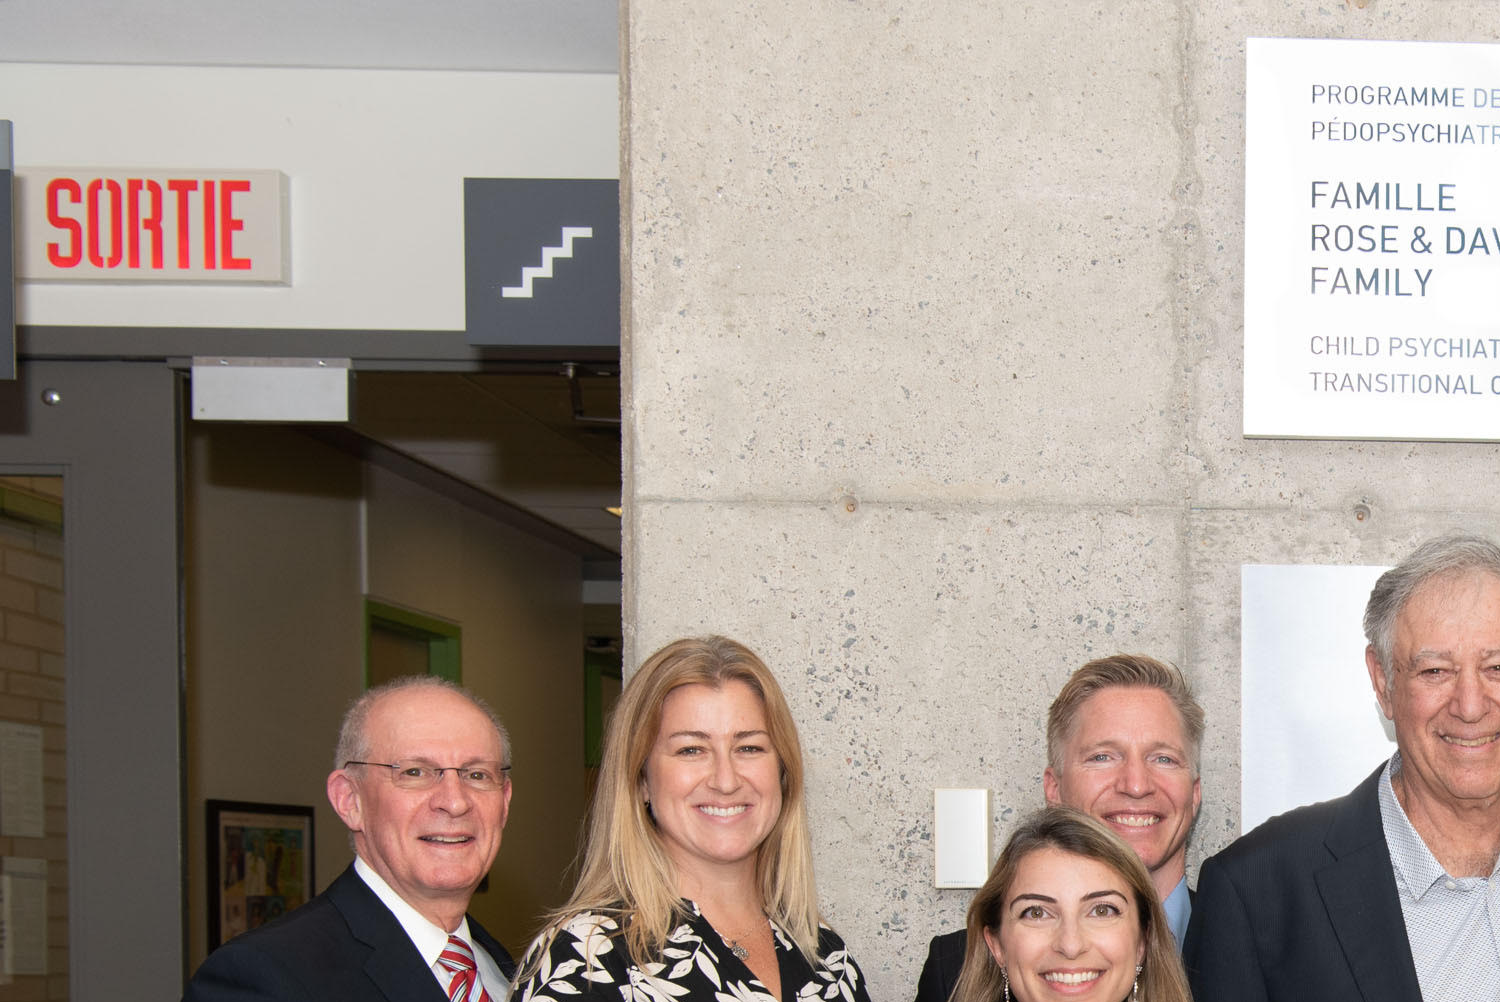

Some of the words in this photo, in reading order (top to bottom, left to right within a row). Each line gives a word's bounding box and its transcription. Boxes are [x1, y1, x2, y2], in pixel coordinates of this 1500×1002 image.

[1311, 84, 1465, 108] PROGRAMME
[1311, 180, 1457, 213] FAMILLE
[46, 178, 252, 270] SORTIE
[1311, 223, 1399, 254] ROSE
[1410, 225, 1433, 255] &
[1310, 266, 1434, 297] FAMILY
[1310, 335, 1380, 357] CHILD
[1308, 371, 1484, 395] TRANSITIONAL
